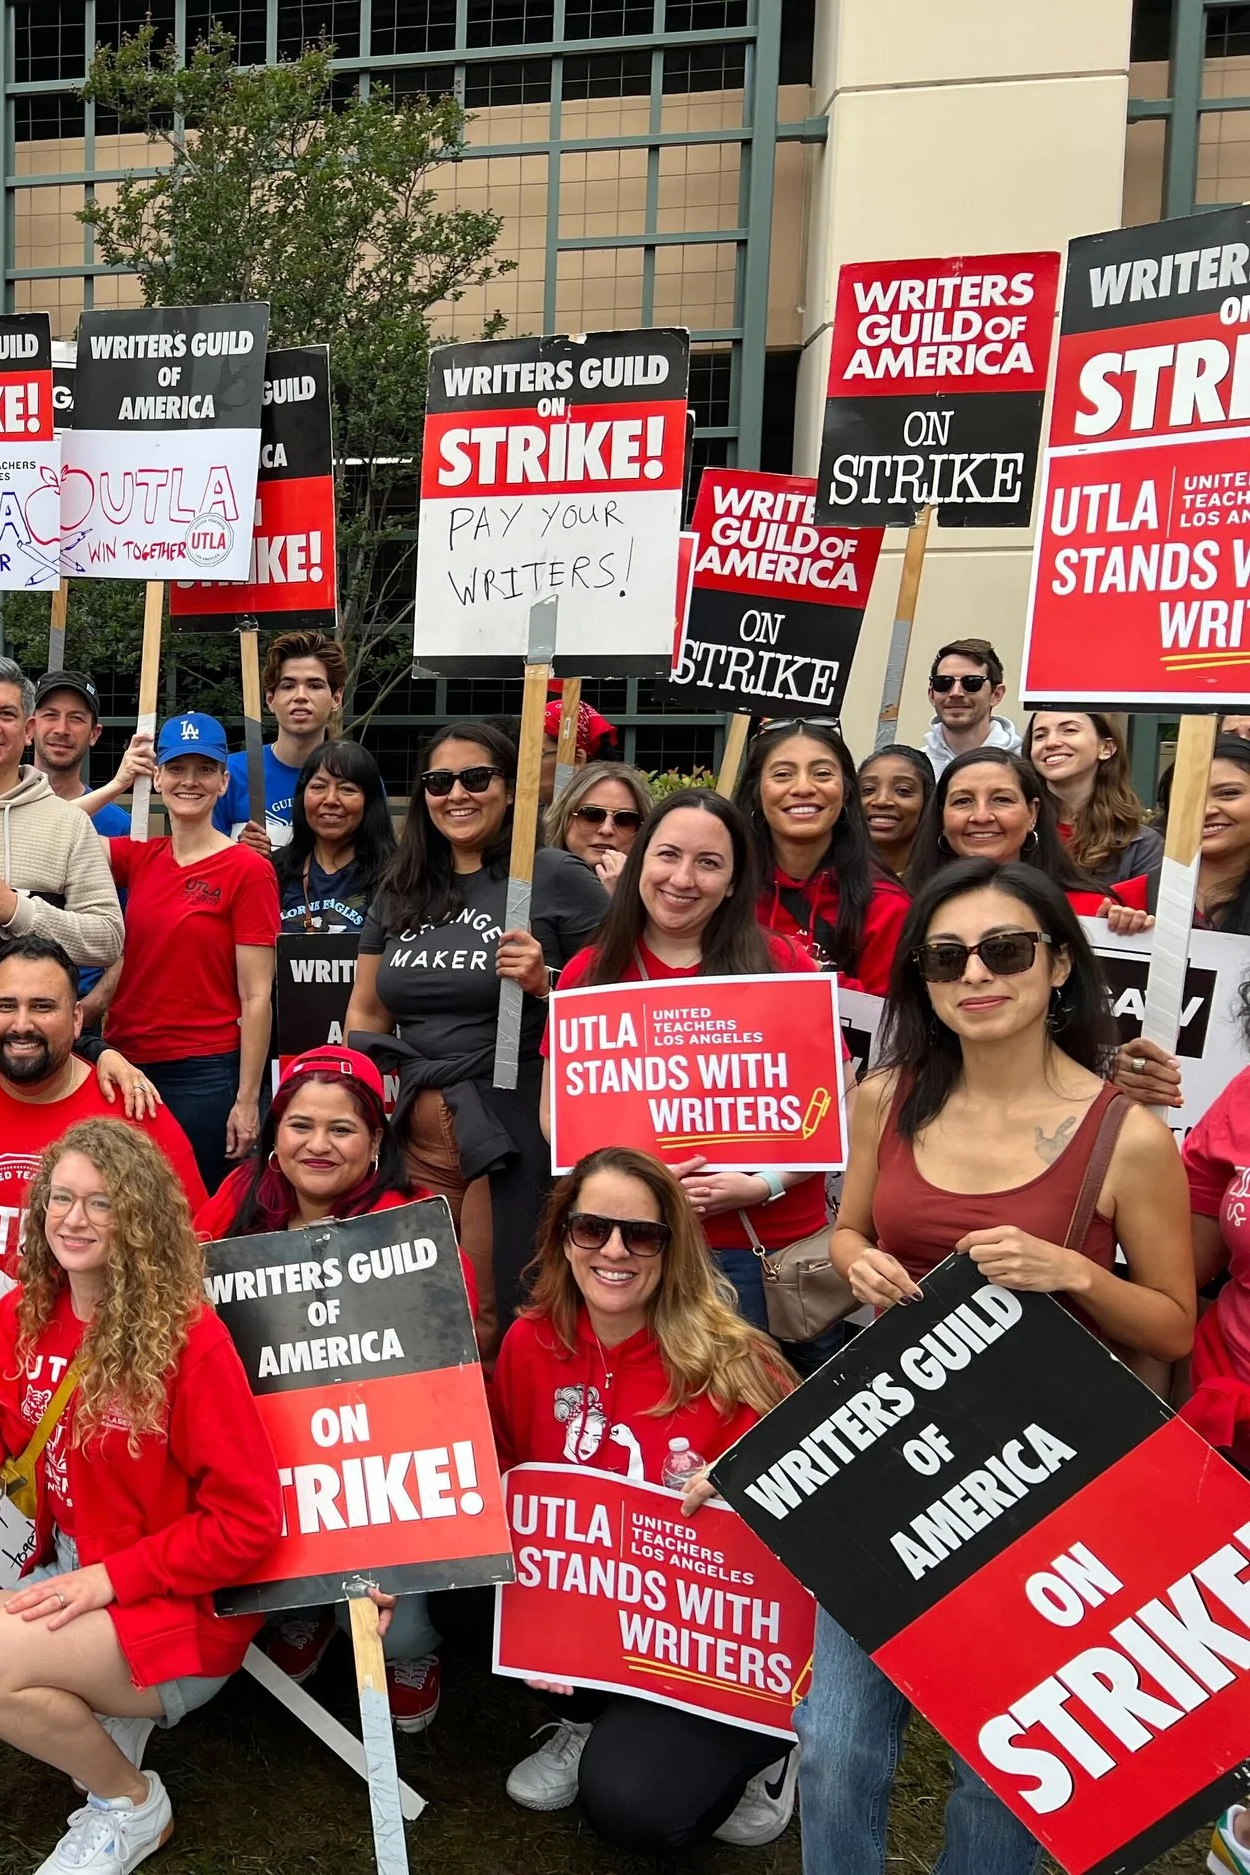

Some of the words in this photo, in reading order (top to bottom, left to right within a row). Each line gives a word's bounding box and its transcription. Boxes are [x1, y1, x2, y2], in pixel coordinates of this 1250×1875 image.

[853, 272, 1034, 313] WRITERS
[1089, 243, 1250, 308] WRITER
[91, 335, 185, 360] WRITERS
[191, 331, 253, 357] GUILD
[857, 311, 983, 346] GUILD
[984, 315, 1027, 341] OF
[158, 368, 181, 387] OF
[443, 361, 573, 397] WRITERS
[580, 355, 669, 386] GUILD
[843, 342, 1034, 380] AMERICA
[118, 395, 215, 421] AMERICA
[262, 376, 316, 405] GUILD
[538, 398, 565, 418] ON
[903, 411, 954, 448] ON
[438, 416, 665, 487] STRIKE!
[100, 466, 239, 524] UTLA
[829, 452, 1025, 506] STRIKE
[450, 503, 523, 551] PAY
[542, 500, 623, 539] YOUR
[1051, 479, 1159, 537] UTLA
[1180, 510, 1218, 527] LOS
[88, 538, 117, 563] WIN
[123, 539, 187, 562] TOGETHER
[192, 533, 226, 550] UTLA
[711, 517, 818, 555] GUILD
[820, 538, 858, 559] OF
[449, 537, 633, 606] WRITERS!
[695, 551, 858, 592] AMERICA
[1052, 539, 1219, 596] STANDS
[740, 611, 785, 644] ON
[669, 639, 839, 705] STRIKE
[180, 720, 199, 741] LA
[390, 949, 487, 970] MAKER
[559, 1012, 638, 1054] UTLA
[653, 1007, 711, 1020] UNITED
[654, 1019, 737, 1033] TEACHERS
[654, 1034, 684, 1046] LOS
[689, 1032, 763, 1044] ANGELES
[565, 1055, 689, 1097] STANDS
[697, 1053, 787, 1090] WITH
[649, 1095, 800, 1134] WRITERS
[204, 1257, 342, 1304] WRITERS
[348, 1238, 437, 1284] GUILD
[308, 1300, 340, 1327] OF
[258, 1329, 404, 1378] AMERICA
[744, 1371, 915, 1520] WRITERS
[899, 1284, 1022, 1390] GUILD
[311, 1403, 369, 1447] ON
[902, 1423, 955, 1476] OF
[280, 1441, 485, 1536] TRIKE!
[889, 1422, 1077, 1581] AMERICA
[512, 1494, 612, 1548] UTLA
[632, 1513, 697, 1541] UNITED
[631, 1542, 664, 1562] LOS
[669, 1554, 754, 1585] ANGELES
[632, 1528, 724, 1564] TEACHERS
[518, 1547, 666, 1612] STANDS
[676, 1579, 780, 1644] WITH
[1025, 1541, 1124, 1627] ON
[618, 1609, 792, 1694] WRITERS
